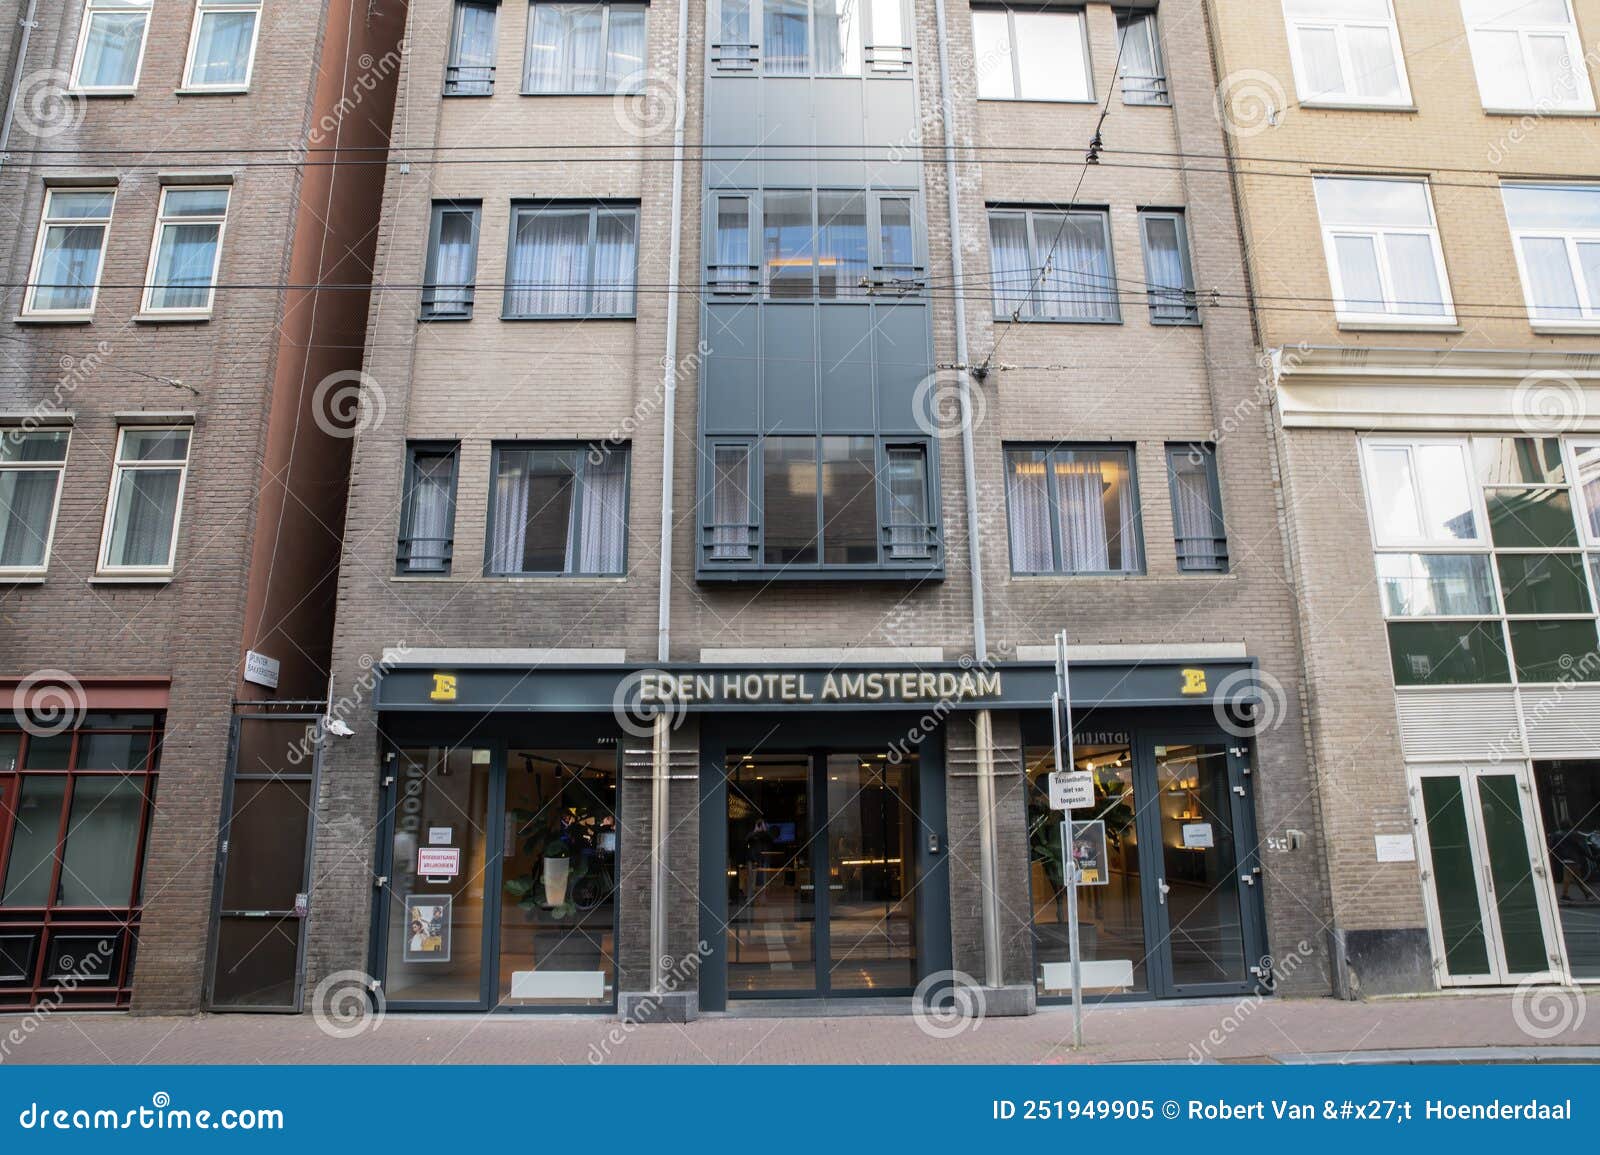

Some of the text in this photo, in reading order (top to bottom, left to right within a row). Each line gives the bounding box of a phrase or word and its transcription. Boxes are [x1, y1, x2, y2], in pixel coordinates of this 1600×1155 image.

[431, 674, 456, 699] E
[639, 670, 1001, 700] EDEN HOTEL AMSTERDAM
[1181, 668, 1207, 693] E
